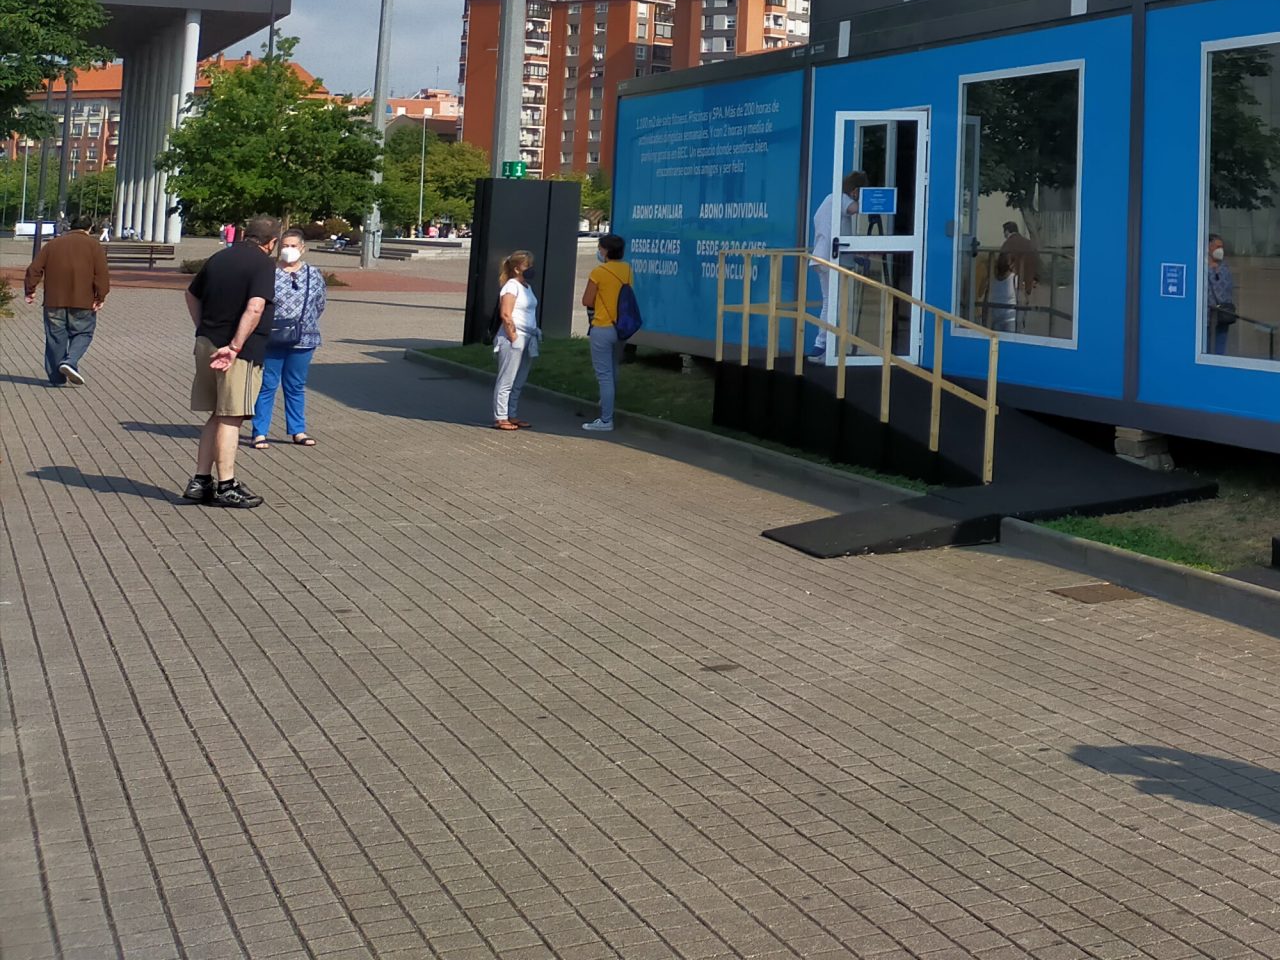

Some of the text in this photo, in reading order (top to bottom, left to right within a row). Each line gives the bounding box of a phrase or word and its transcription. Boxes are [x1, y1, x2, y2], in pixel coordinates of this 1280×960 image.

[772, 99, 780, 113] de
[632, 204, 683, 219] ABONO FAMILIAR
[699, 202, 768, 219] ABONO INDIVIDUAL
[631, 238, 651, 254] DESDE
[696, 240, 719, 255] DESDE
[632, 258, 648, 274] TODO
[701, 262, 758, 280] TODO NCLUO
